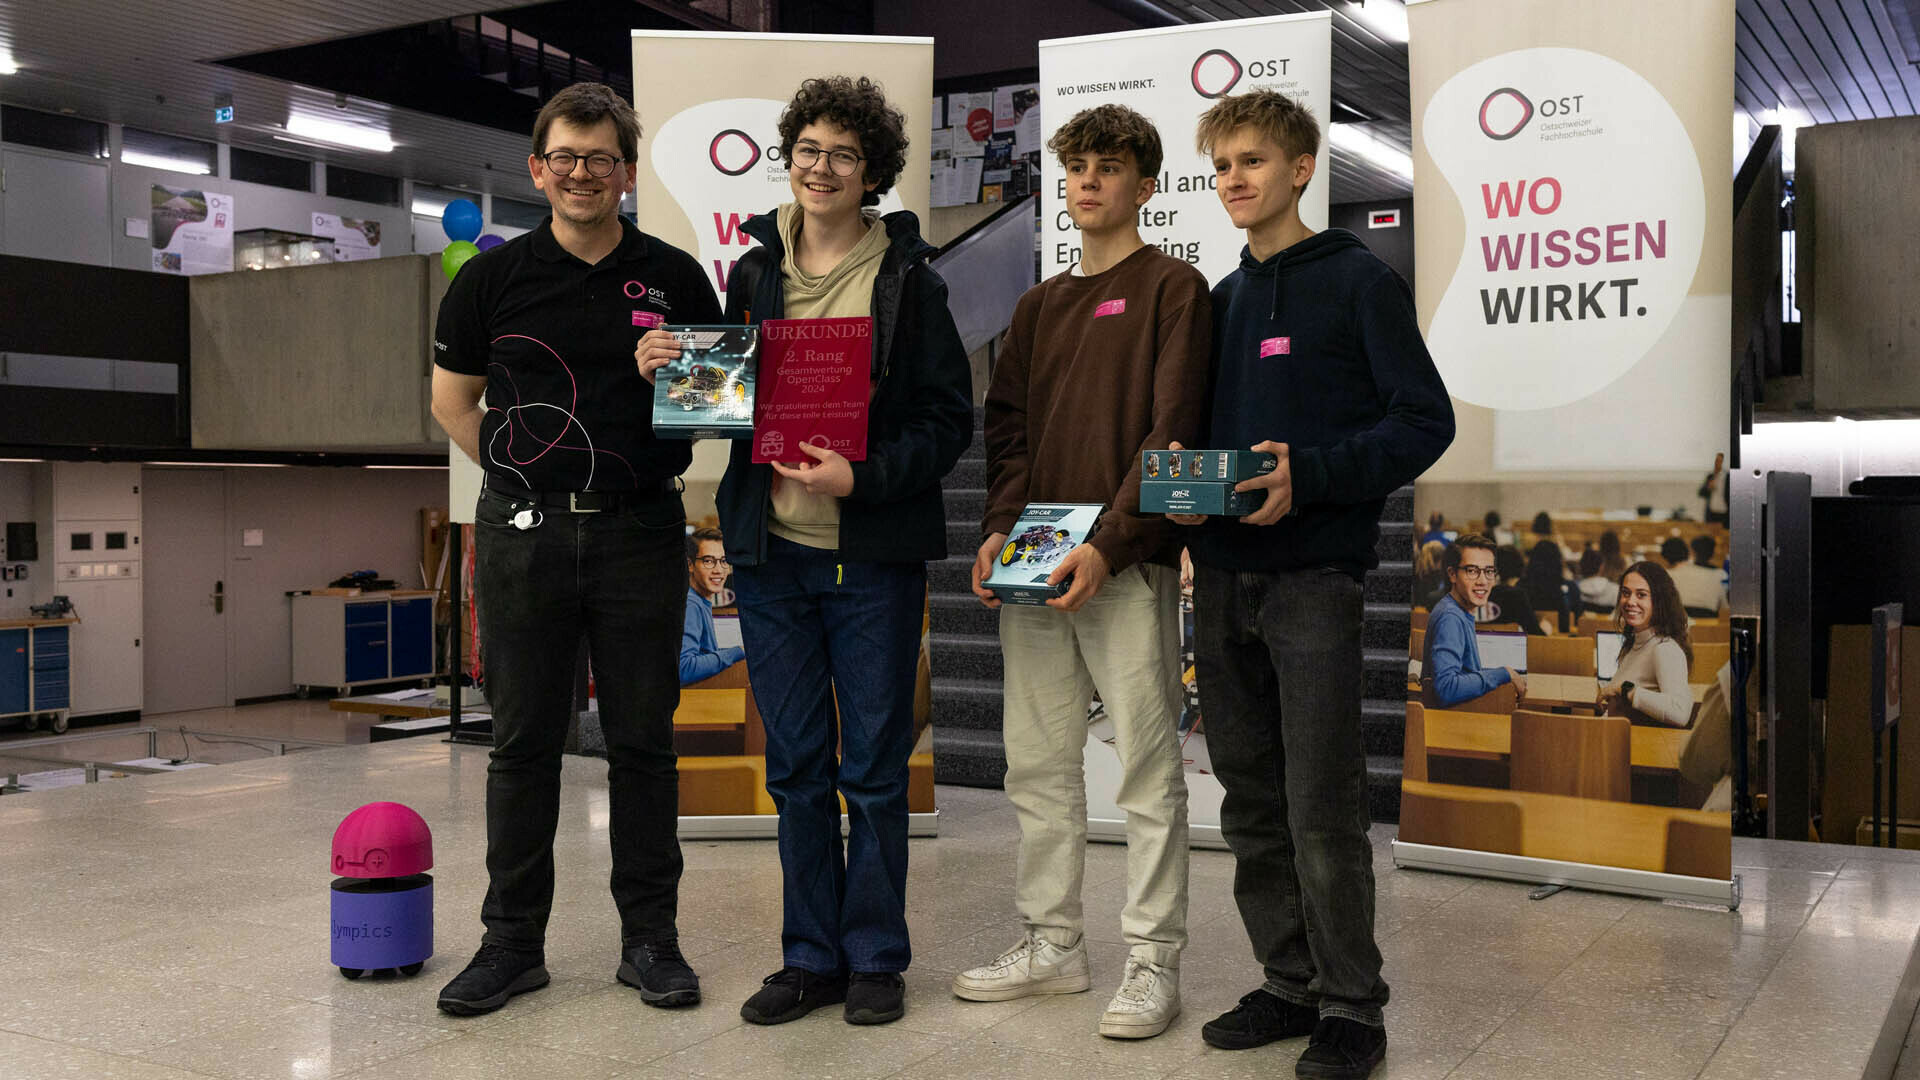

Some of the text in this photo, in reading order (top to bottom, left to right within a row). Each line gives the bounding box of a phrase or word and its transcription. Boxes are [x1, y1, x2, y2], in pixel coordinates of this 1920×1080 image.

[1248, 58, 1290, 78] OST
[1057, 79, 1156, 96] WO WISSEN WIRKT.
[1540, 95, 1583, 117] OST
[1481, 176, 1562, 219] WO
[1480, 219, 1666, 272] WISSEN
[648, 287, 665, 299] OST
[1480, 278, 1647, 325] WIRKT.
[767, 323, 869, 340] URKUNDE
[786, 349, 845, 364] 2. Rang
[777, 366, 853, 376] Gesamtwertung
[787, 374, 841, 385] OpenClass
[802, 384, 825, 394] 2024
[776, 401, 820, 412] gratulieren
[822, 400, 841, 409] dem
[843, 400, 865, 408] Team
[330, 919, 393, 941] lympics
